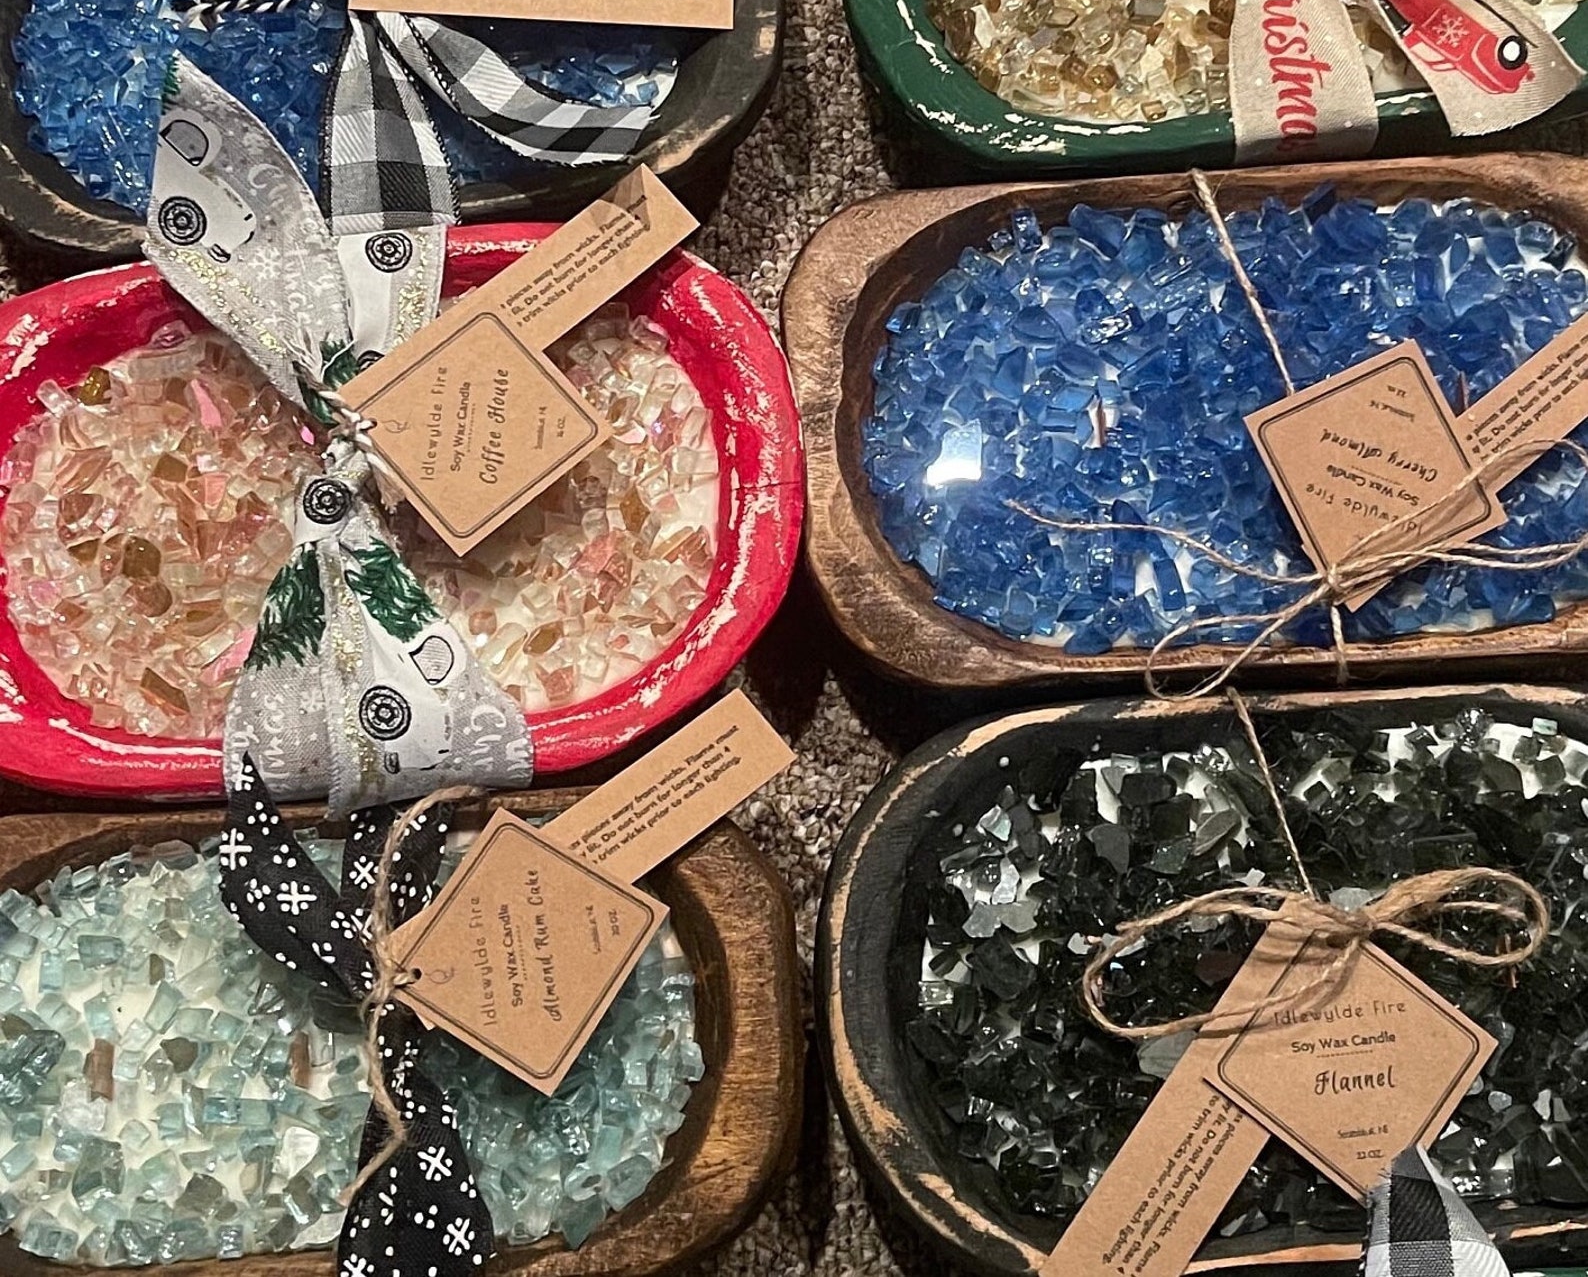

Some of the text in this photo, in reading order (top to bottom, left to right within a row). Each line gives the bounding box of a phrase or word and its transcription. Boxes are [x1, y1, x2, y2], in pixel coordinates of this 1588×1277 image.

[418, 366, 447, 481] Idlewylde Fire
[449, 381, 471, 472] Soy Wax Candle
[477, 368, 509, 484] Coffee House
[1319, 427, 1438, 482] Cherry Almond
[1305, 482, 1335, 504] Fire
[1325, 464, 1420, 506] Soy Wax Candle
[633, 784, 658, 803] from
[684, 743, 715, 766] Flame
[714, 724, 739, 745] must
[655, 788, 671, 802] for
[670, 767, 701, 792] longer
[701, 752, 723, 769] than
[619, 823, 647, 844] wicks
[646, 806, 670, 828] prior
[682, 781, 705, 799] each
[467, 895, 498, 1026] Idlewylde Fire
[497, 903, 524, 1007] Soy Wax Candle
[523, 869, 562, 1022] Almond Rum Cake
[1272, 996, 1407, 1027] Idlewylde Fire
[1290, 1030, 1396, 1054] Soy Wax Candle
[1313, 1064, 1395, 1095] Flannel
[1191, 1107, 1211, 1131] trim
[1173, 1131, 1195, 1159] wicks
[1187, 1144, 1203, 1164] not
[1211, 1122, 1236, 1156] pieces
[1155, 1157, 1176, 1187] prior
[1171, 1163, 1193, 1189] burn
[1194, 1155, 1214, 1182] away
[1162, 1189, 1176, 1205] for
[1177, 1181, 1199, 1208] from
[1129, 1199, 1149, 1225] each
[1139, 1205, 1165, 1240] longer
[1121, 1239, 1142, 1264] than
[1134, 1240, 1161, 1273] Flame
